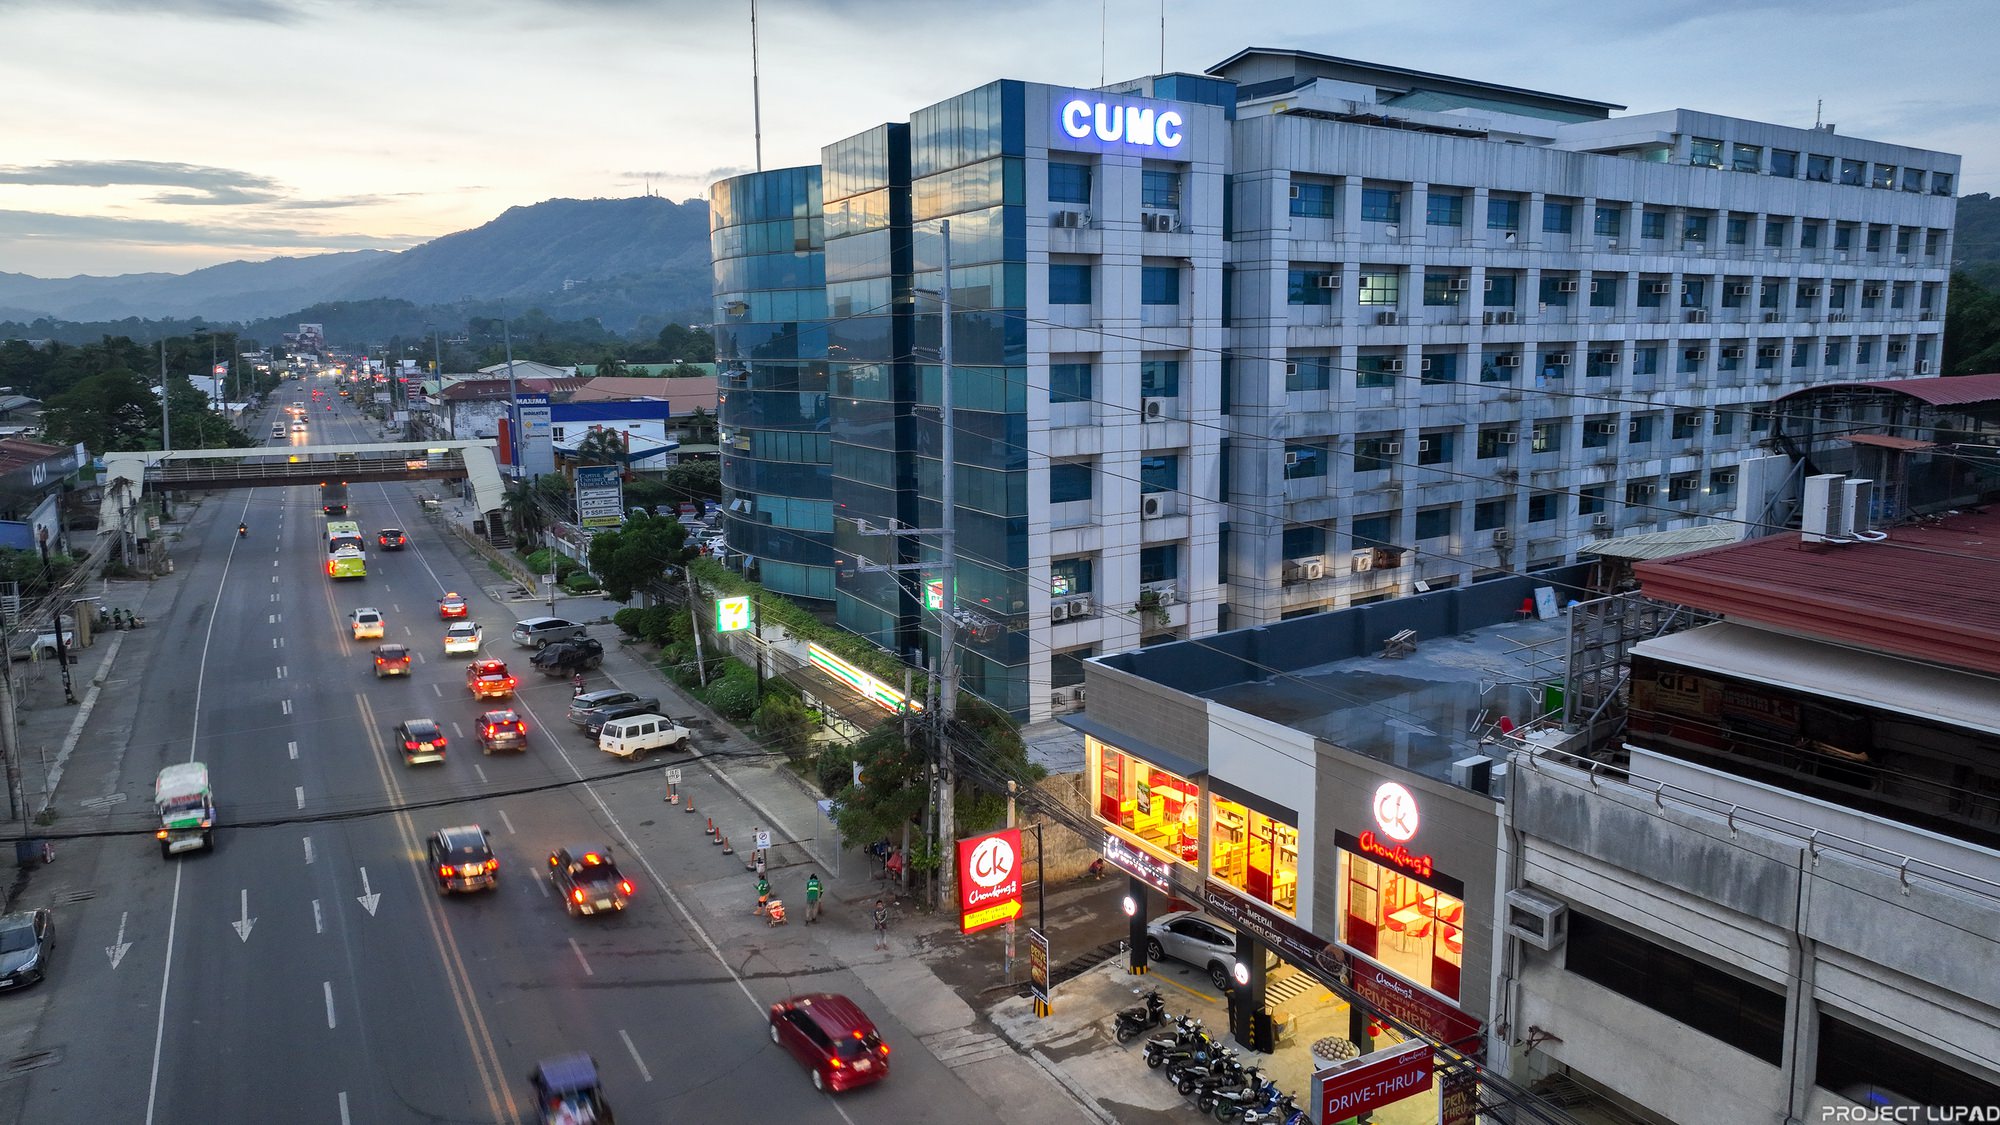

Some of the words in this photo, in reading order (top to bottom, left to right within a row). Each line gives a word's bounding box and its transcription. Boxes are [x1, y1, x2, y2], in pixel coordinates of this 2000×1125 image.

[1062, 100, 1182, 148] CUMC
[976, 845, 1009, 878] Ck
[1360, 830, 1422, 875] Chowking
[968, 884, 1012, 904] Chowking
[1238, 916, 1265, 936] CHICKEN
[1264, 930, 1283, 947] CHOP
[1246, 908, 1274, 929] IMPERIAL
[1375, 972, 1409, 999] Chowking
[1356, 983, 1392, 1013] DRIVE
[1391, 1003, 1428, 1032] THRU
[1328, 1071, 1415, 1115] DRIVE-THRU
